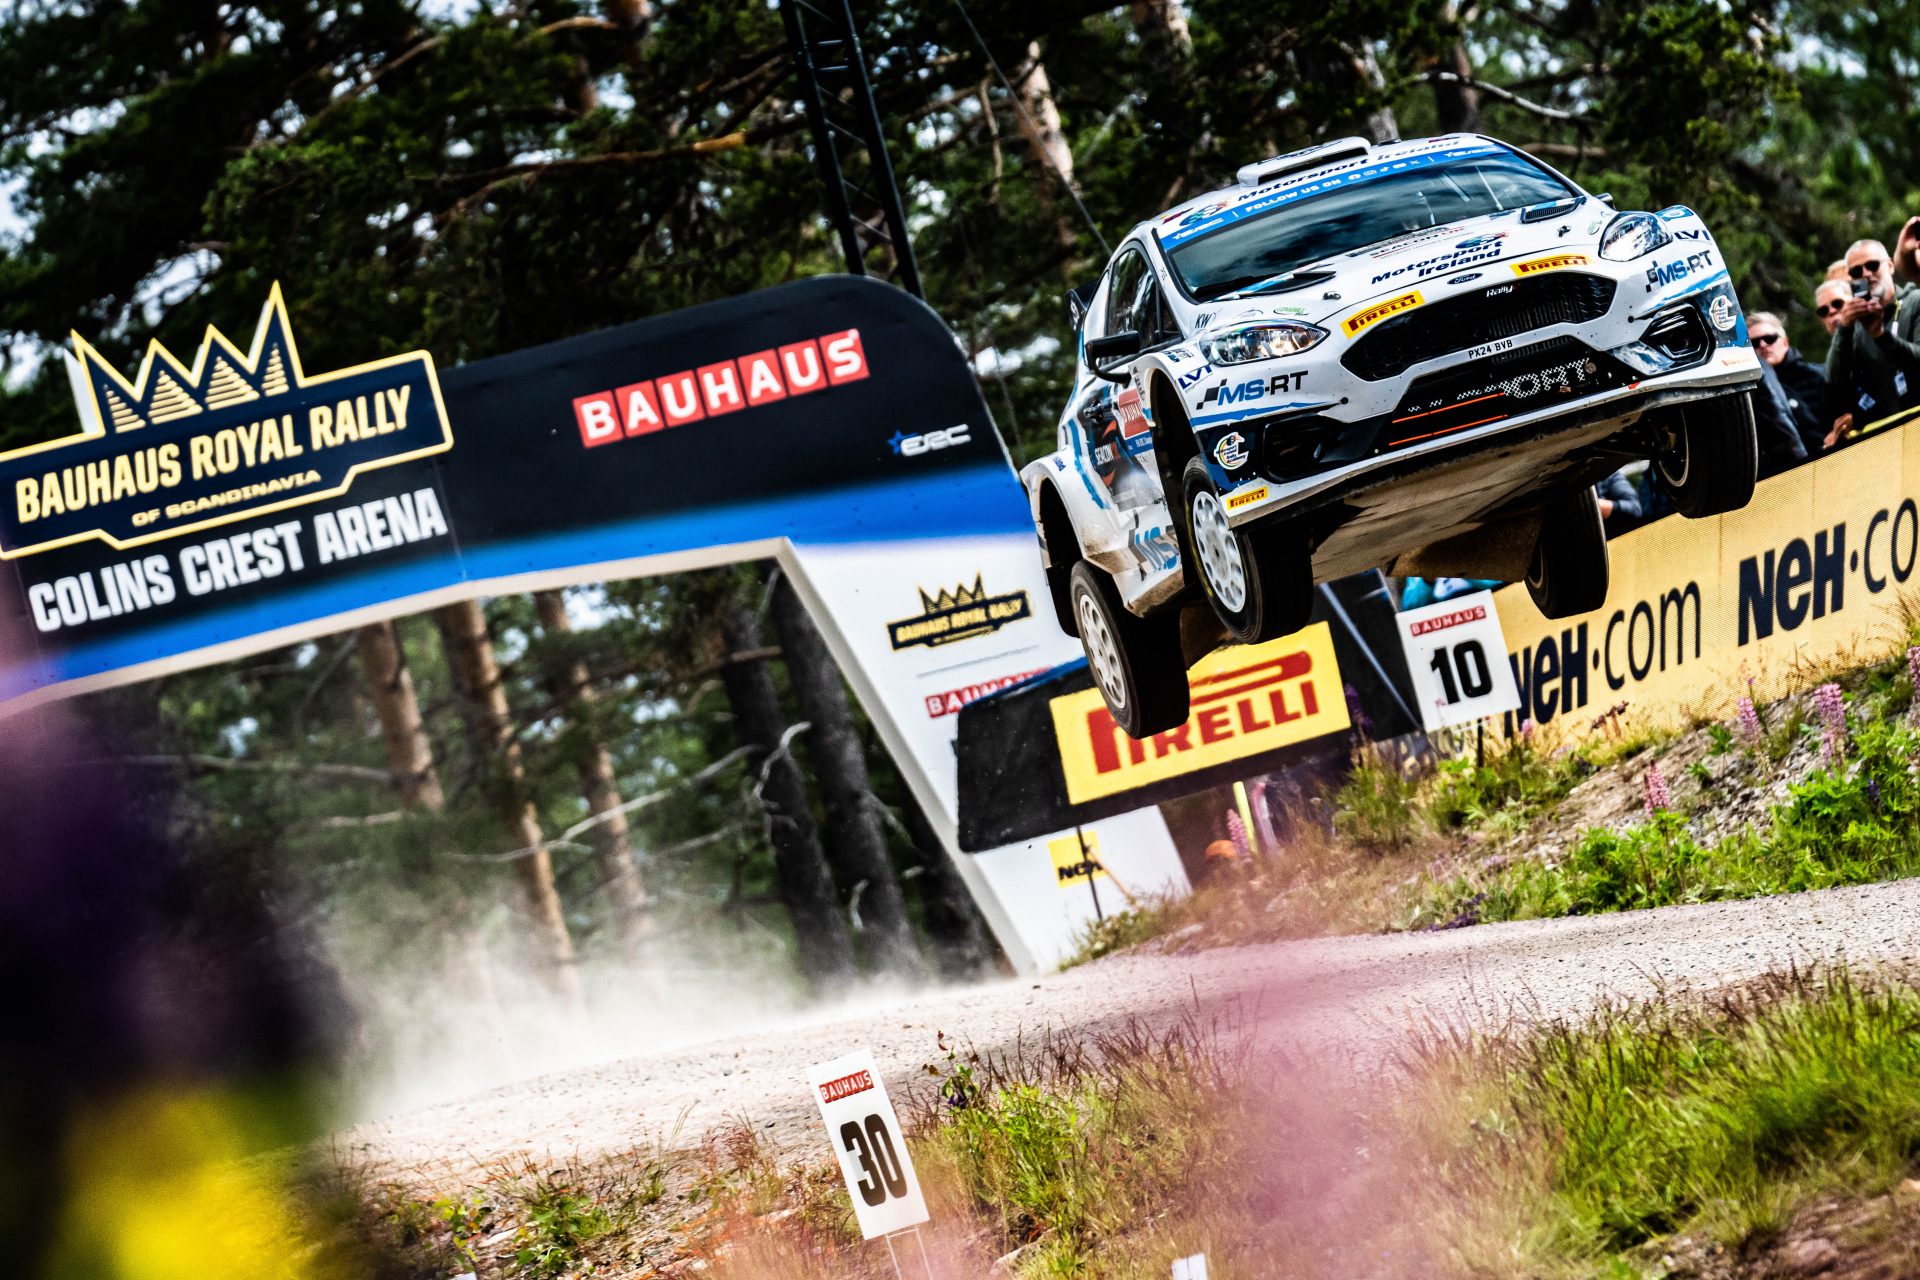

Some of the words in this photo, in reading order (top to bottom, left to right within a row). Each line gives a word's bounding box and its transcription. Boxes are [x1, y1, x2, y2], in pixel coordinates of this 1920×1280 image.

[1238, 157, 1368, 202] Motorsport
[1377, 140, 1459, 160] Ireland
[1245, 191, 1298, 212] FOLLOW
[1302, 184, 1320, 194] US
[1322, 178, 1342, 188] ON
[1674, 230, 1711, 241] LVI
[1371, 240, 1503, 284] Motorsport
[1418, 249, 1501, 277] Ireland
[1453, 273, 1477, 284] Ford
[1518, 256, 1588, 274] PIRELLI
[1348, 293, 1417, 333] PIRELLI
[1468, 346, 1493, 360] PX24
[1495, 338, 1513, 350] BVB
[580, 332, 863, 441] BAUHAUS
[1178, 365, 1213, 390] LVI
[1218, 370, 1309, 407] MS-RT
[16, 444, 182, 523] BAUHAUS
[190, 414, 303, 480] ROYAL
[309, 385, 412, 451] RALLY
[132, 505, 161, 528] OF
[166, 469, 322, 520] SCANDINAVIA
[1230, 489, 1265, 508] PIRELLI
[29, 554, 176, 633] COLINS
[179, 521, 303, 596] CREST
[313, 487, 449, 564] ARENA
[1411, 607, 1486, 636] BAUHAUS
[1430, 639, 1493, 705] 10
[820, 1070, 874, 1102] BAUHAUS
[840, 1113, 909, 1208] 30
